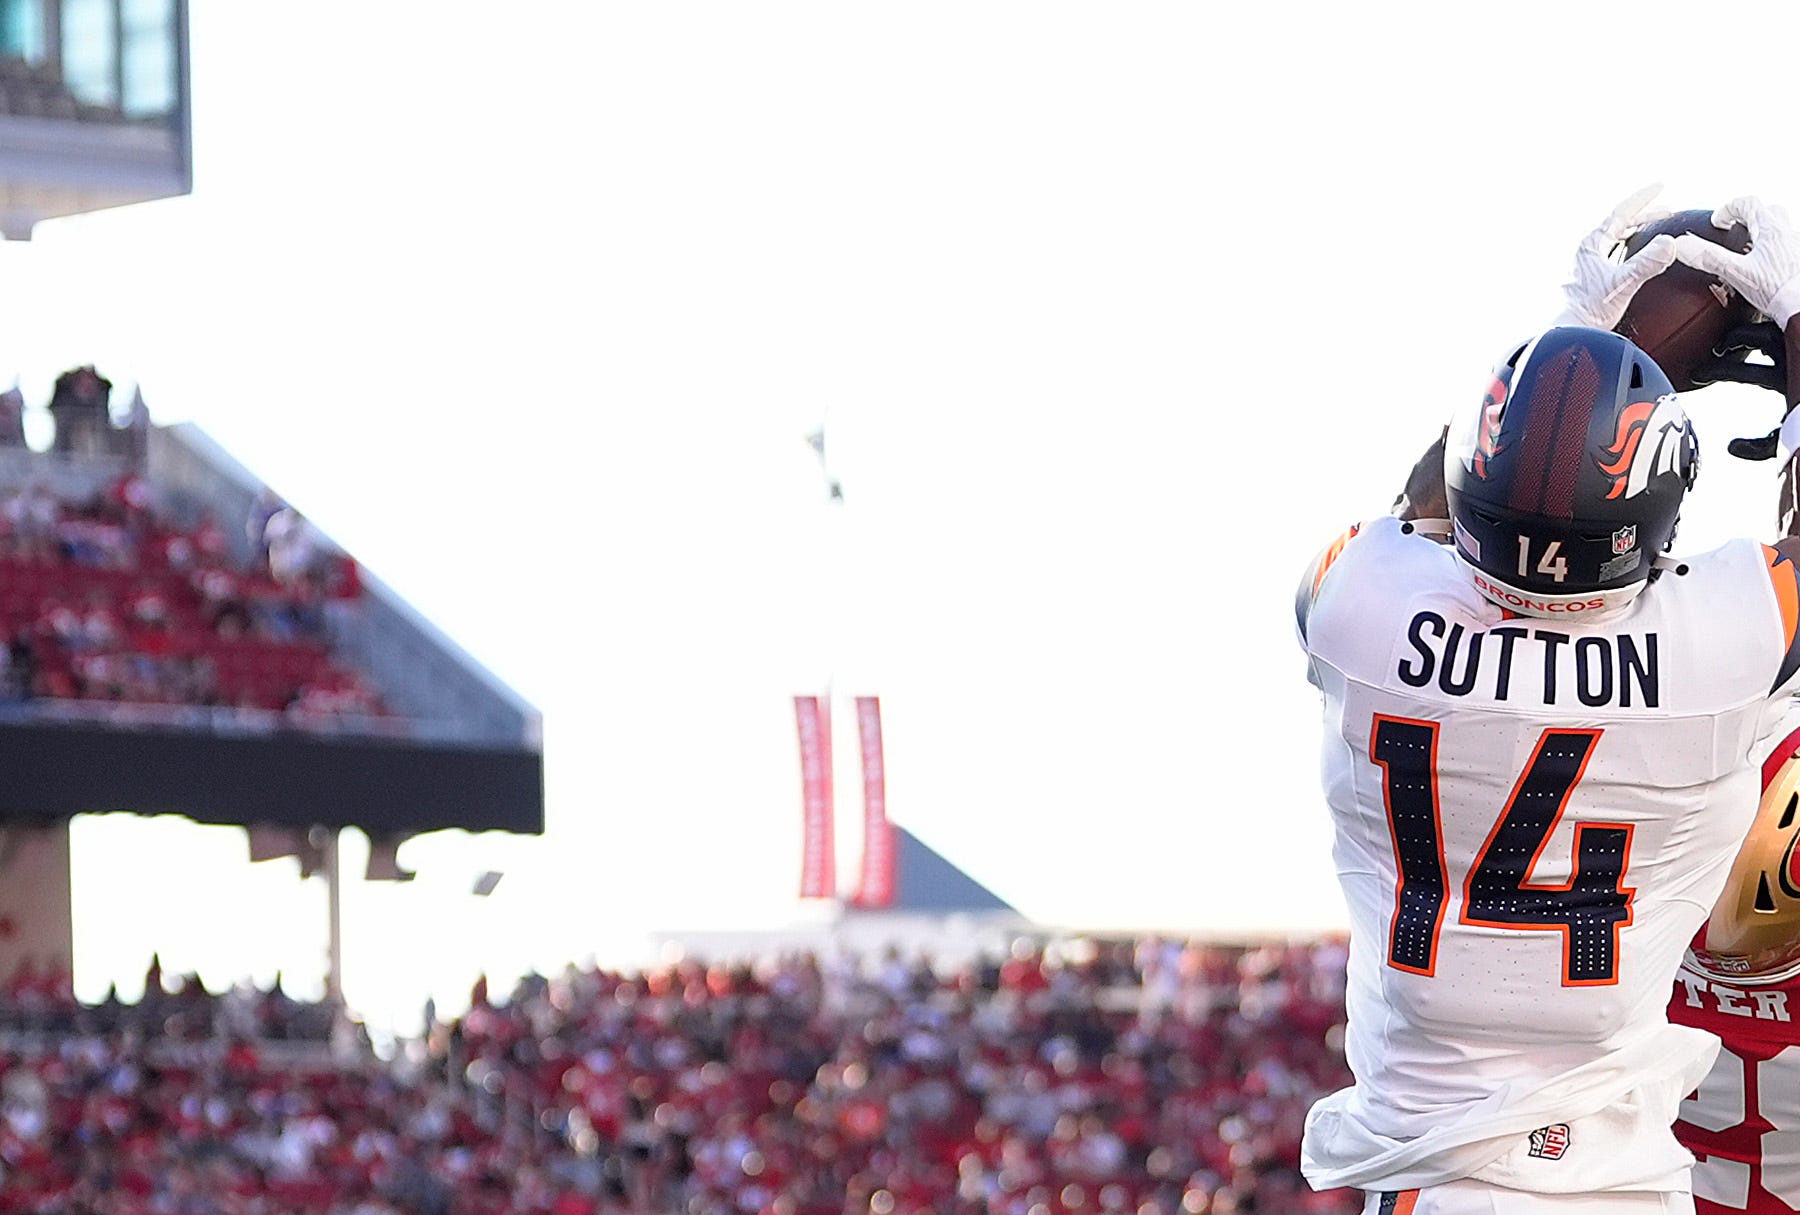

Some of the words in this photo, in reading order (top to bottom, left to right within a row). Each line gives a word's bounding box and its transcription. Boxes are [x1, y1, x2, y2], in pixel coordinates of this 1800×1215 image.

[1517, 534, 1569, 583] 14
[1474, 575, 1605, 613] BRONCOS
[1398, 611, 1659, 708] SUTTON
[1369, 712, 1637, 987] 14
[1542, 1127, 1566, 1157] NFL
